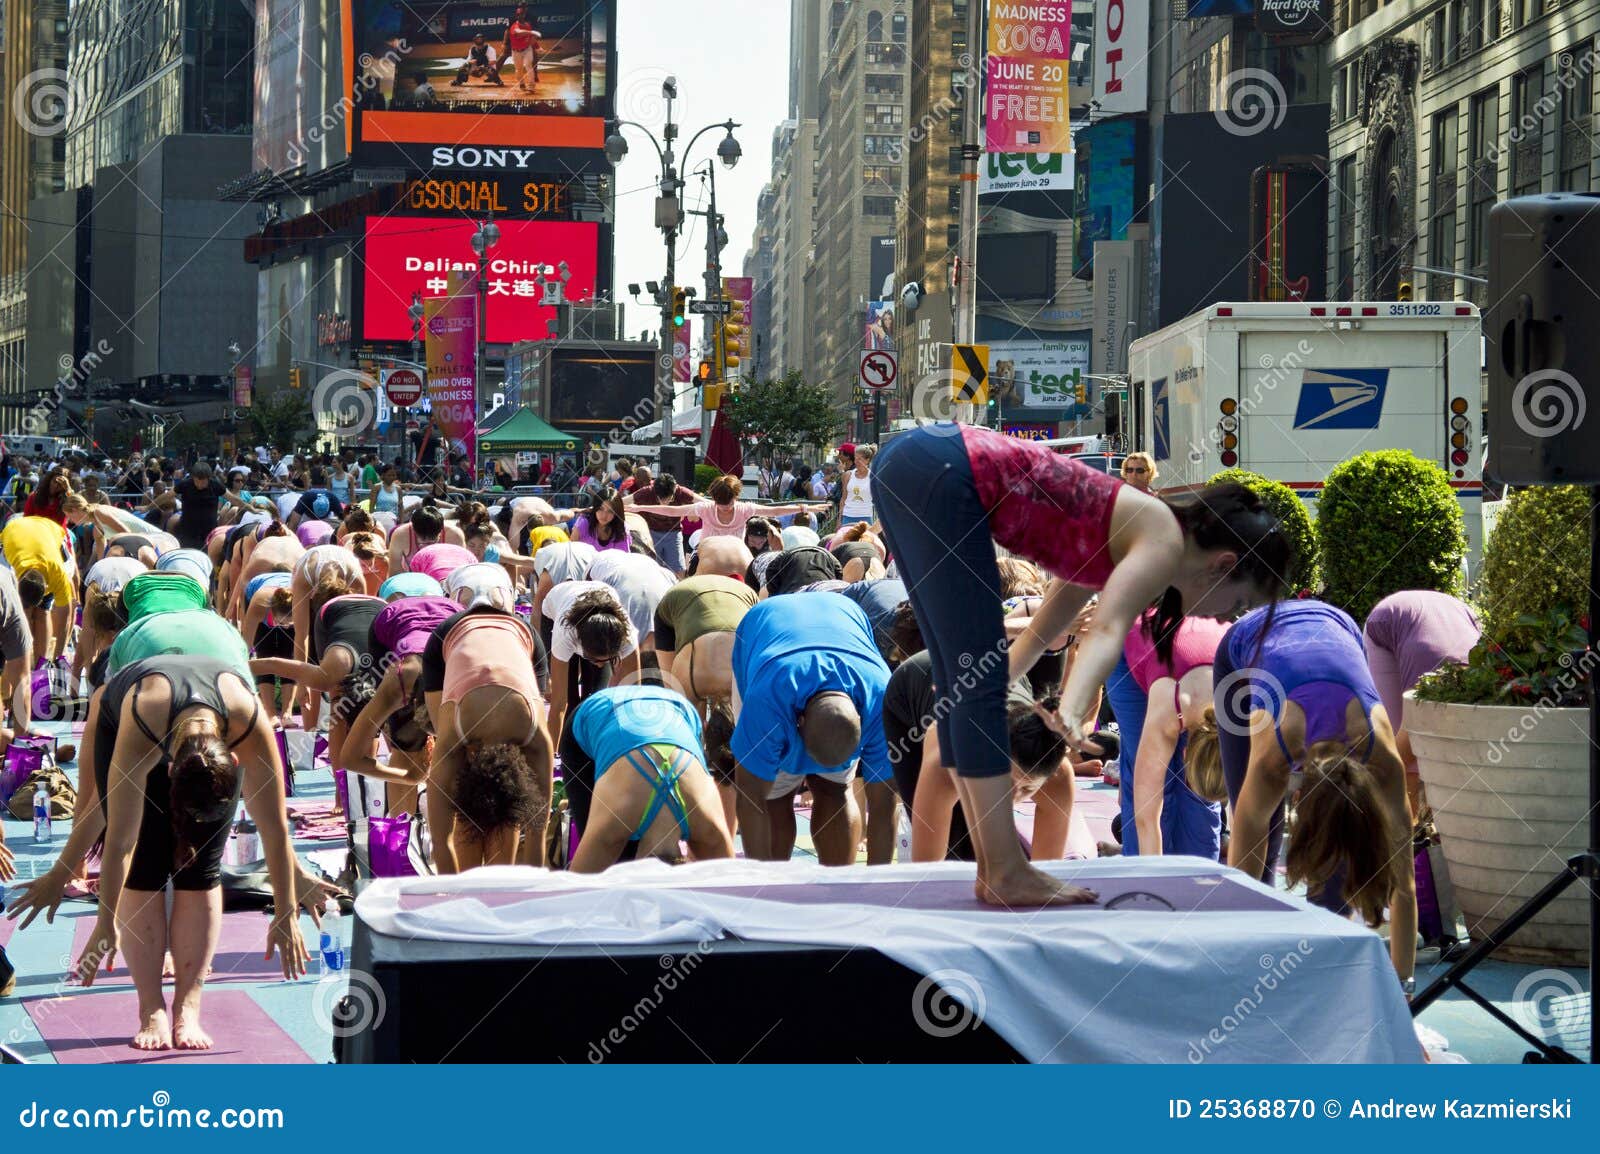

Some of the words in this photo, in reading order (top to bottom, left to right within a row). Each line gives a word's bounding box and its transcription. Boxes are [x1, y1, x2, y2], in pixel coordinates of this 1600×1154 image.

[995, 4, 1067, 23] MADNESS
[1262, 0, 1290, 11] Hard
[1292, 0, 1320, 12] Rock
[994, 23, 1064, 54] YOGA
[993, 62, 1035, 81] JUNE
[1042, 65, 1063, 82] 20
[992, 94, 1065, 122] FREE!
[432, 147, 536, 168] SONY
[1039, 178, 1050, 187] 29
[405, 257, 477, 272] Dalian
[490, 259, 555, 275] China
[1107, 267, 1117, 317] REUTERS
[1389, 304, 1441, 316] 3511202
[918, 318, 931, 340] LIVE
[1042, 342, 1068, 353] family
[1070, 343, 1088, 353] guy
[1106, 320, 1118, 373] THOMSON
[917, 342, 941, 376] FAST
[391, 376, 402, 384] DO
[403, 376, 416, 384] NOT
[428, 378, 449, 388] MIND
[451, 377, 473, 387] OVER
[1029, 367, 1080, 395] ted
[393, 392, 416, 401] ENTER
[429, 390, 473, 401] MADNESS
[1041, 395, 1057, 403] june
[1058, 394, 1068, 403] 29
[432, 403, 475, 425] YOGA
